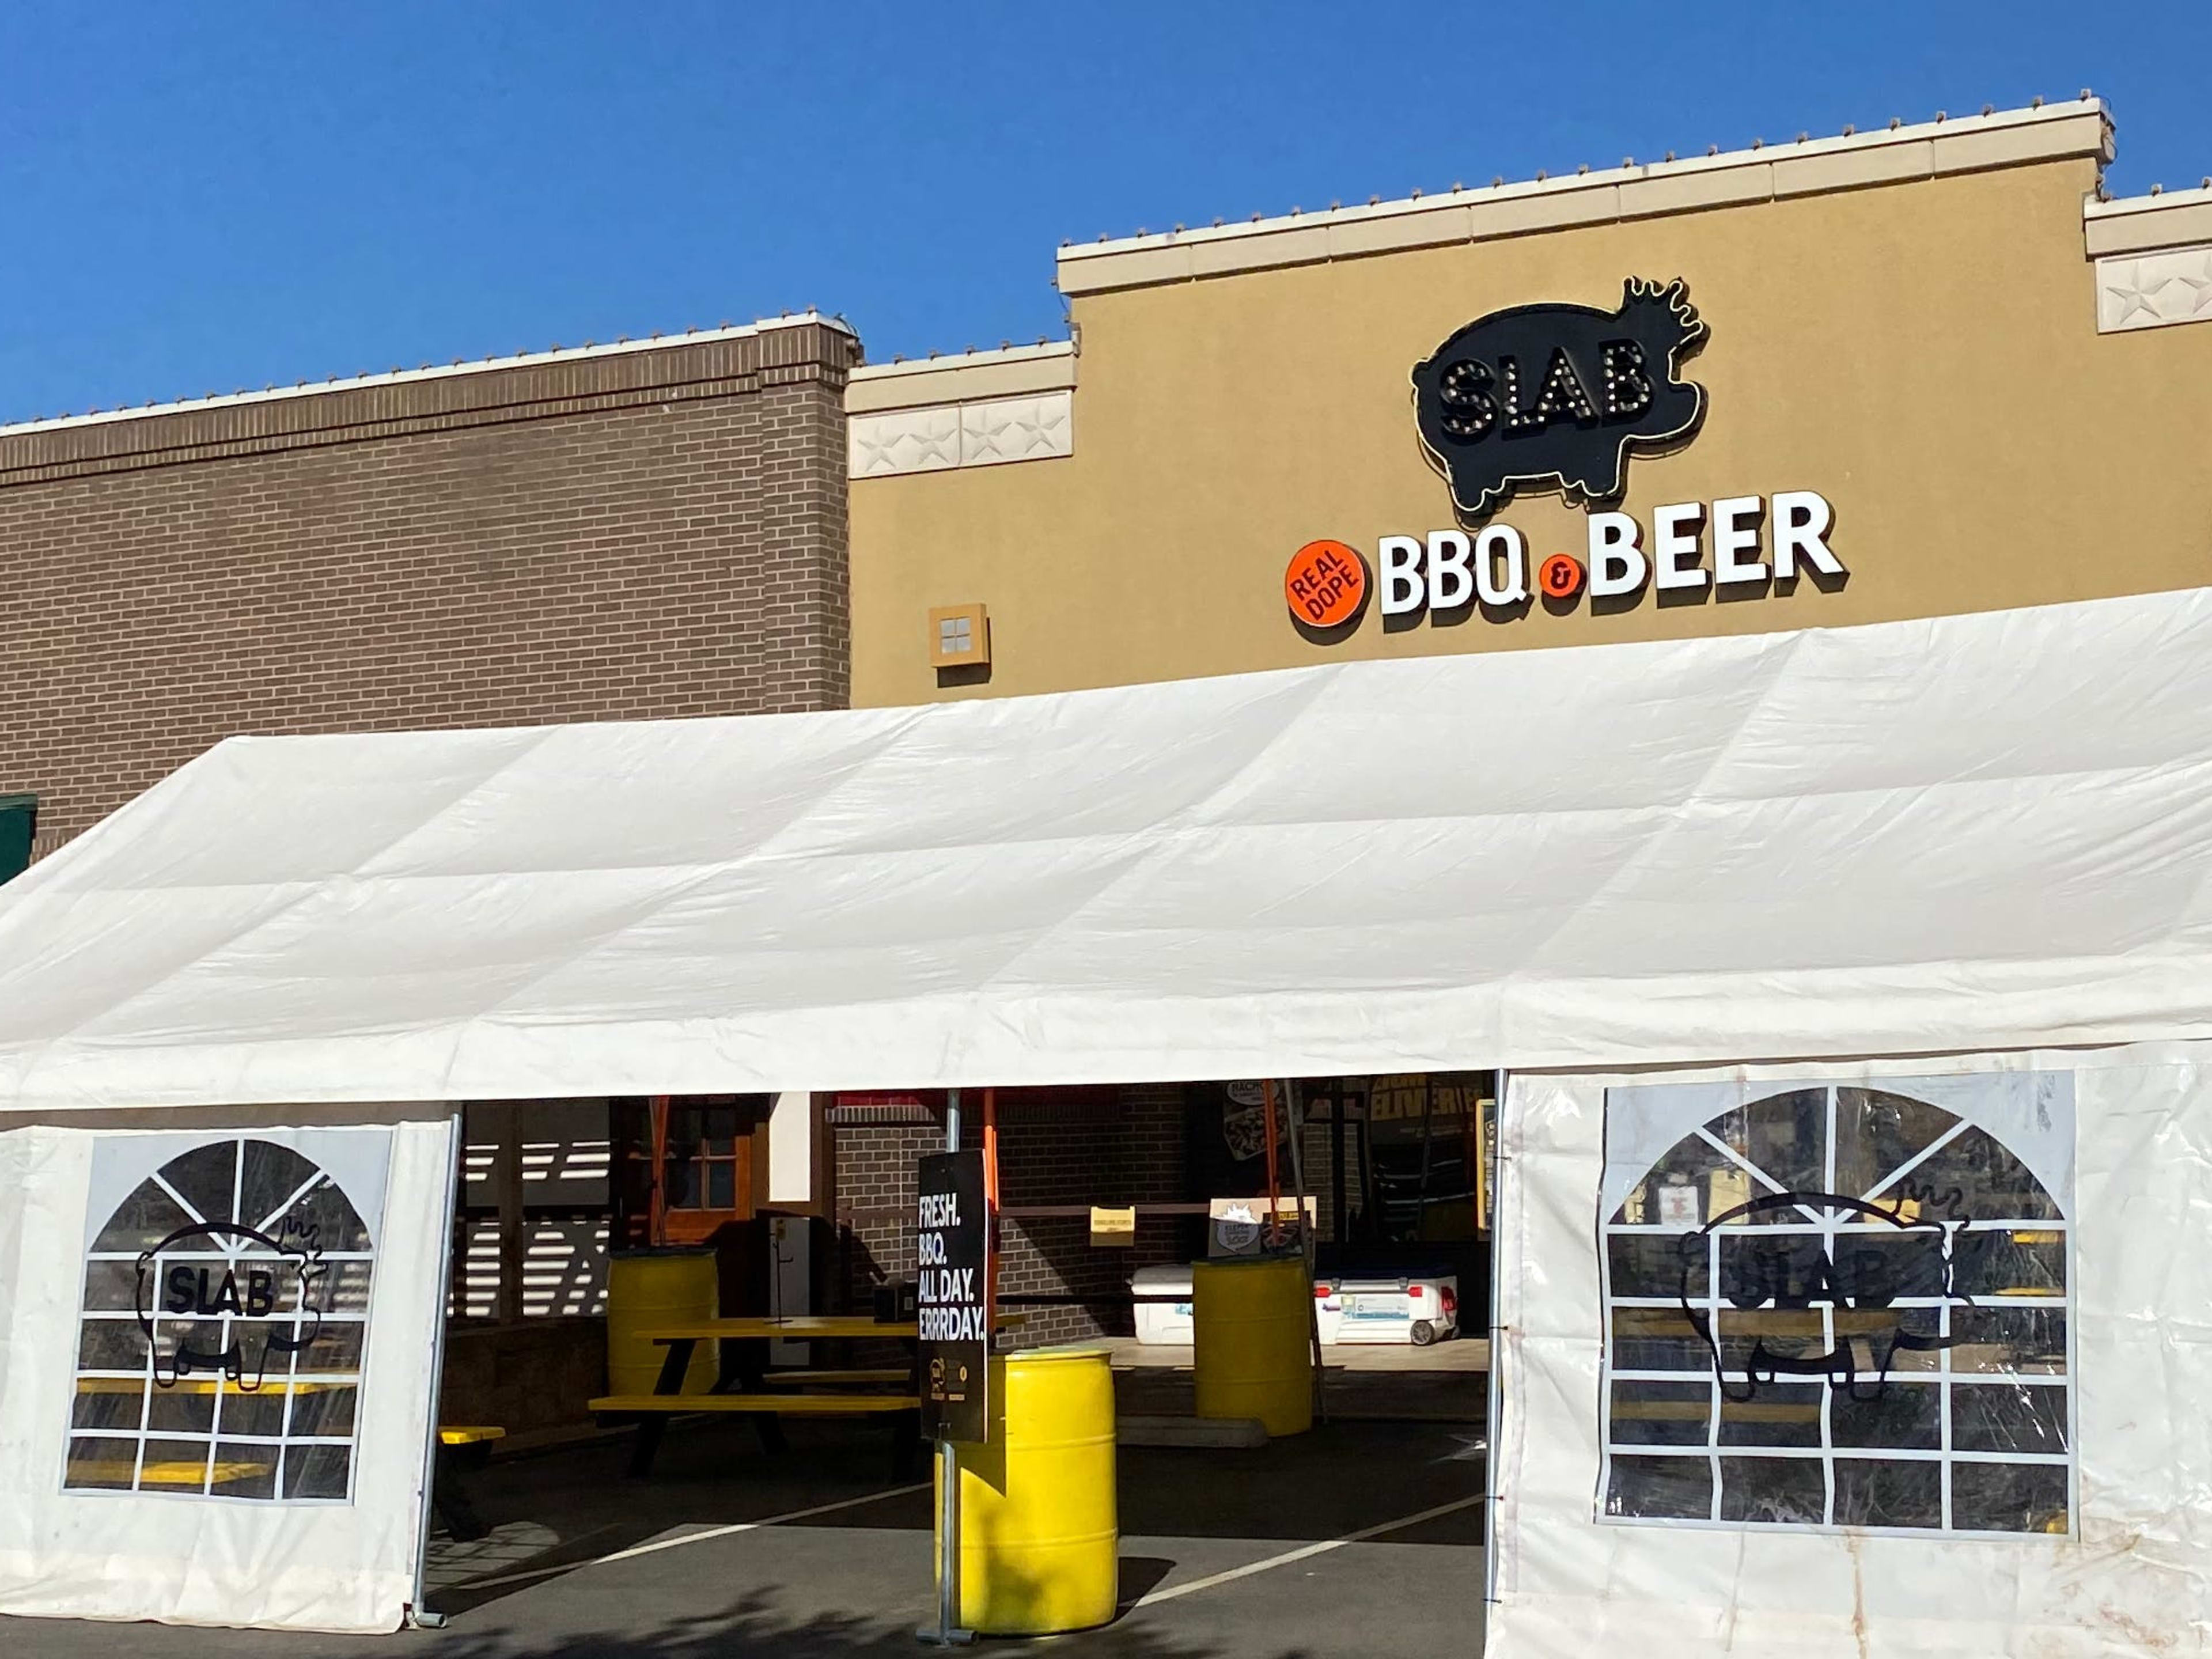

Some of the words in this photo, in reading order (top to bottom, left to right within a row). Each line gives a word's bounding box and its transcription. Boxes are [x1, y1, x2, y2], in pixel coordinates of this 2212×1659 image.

[1440, 339, 1655, 445] SLAB
[1290, 550, 1344, 601] REAL
[1378, 524, 1528, 615] BBQ
[1551, 562, 1571, 590] &
[1588, 491, 1844, 597] BEER
[1305, 565, 1359, 621] DOPE
[919, 1192, 961, 1228] FRESH.
[919, 1232, 947, 1266] BBQ.
[165, 1266, 274, 1317] SLAB
[918, 1270, 938, 1302] ALL
[940, 1268, 975, 1302] DAY.
[919, 1306, 984, 1341] ERRRDAY.
